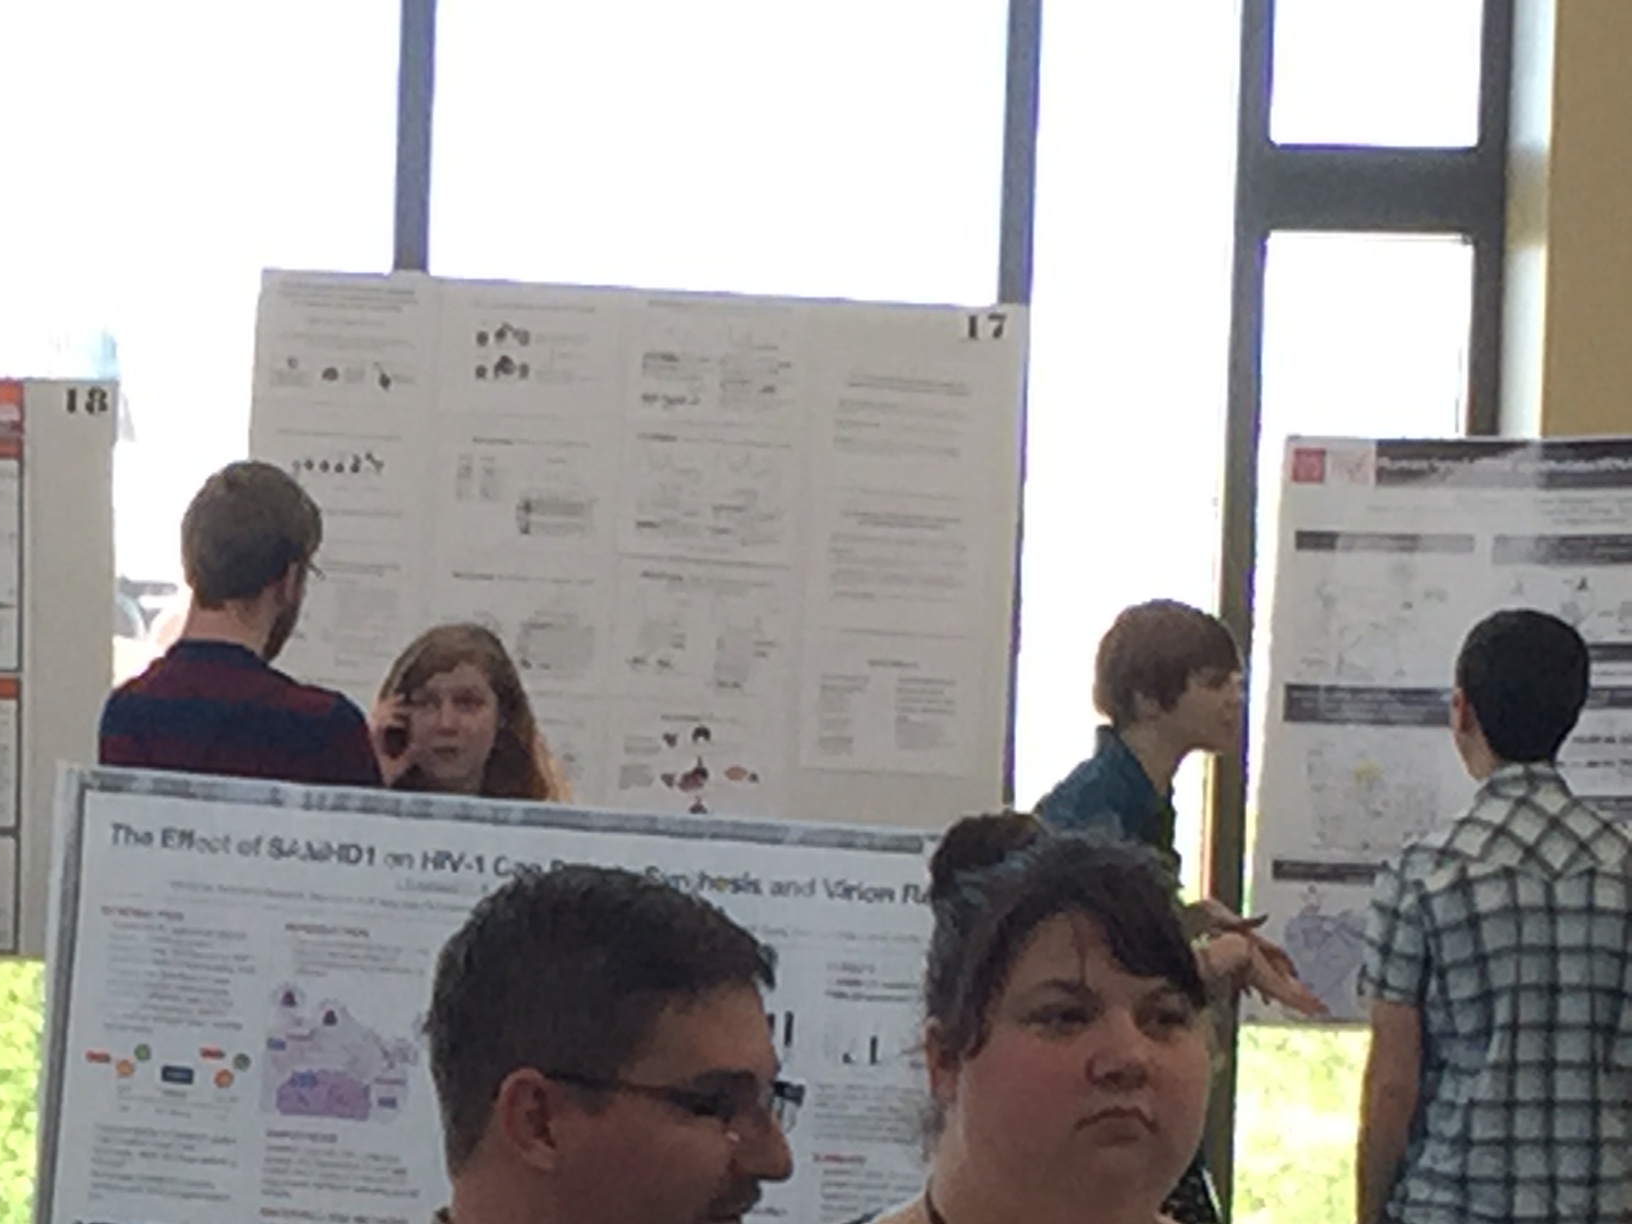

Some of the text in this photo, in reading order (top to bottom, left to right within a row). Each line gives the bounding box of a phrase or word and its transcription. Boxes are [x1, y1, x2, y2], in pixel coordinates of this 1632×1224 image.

[968, 312, 1008, 341] 17
[66, 386, 109, 416] 18
[110, 822, 154, 848] The
[160, 826, 232, 855] Effect
[236, 834, 264, 858] of
[419, 849, 486, 875] HIV-1
[768, 876, 817, 898] and
[822, 877, 896, 904] Virion
